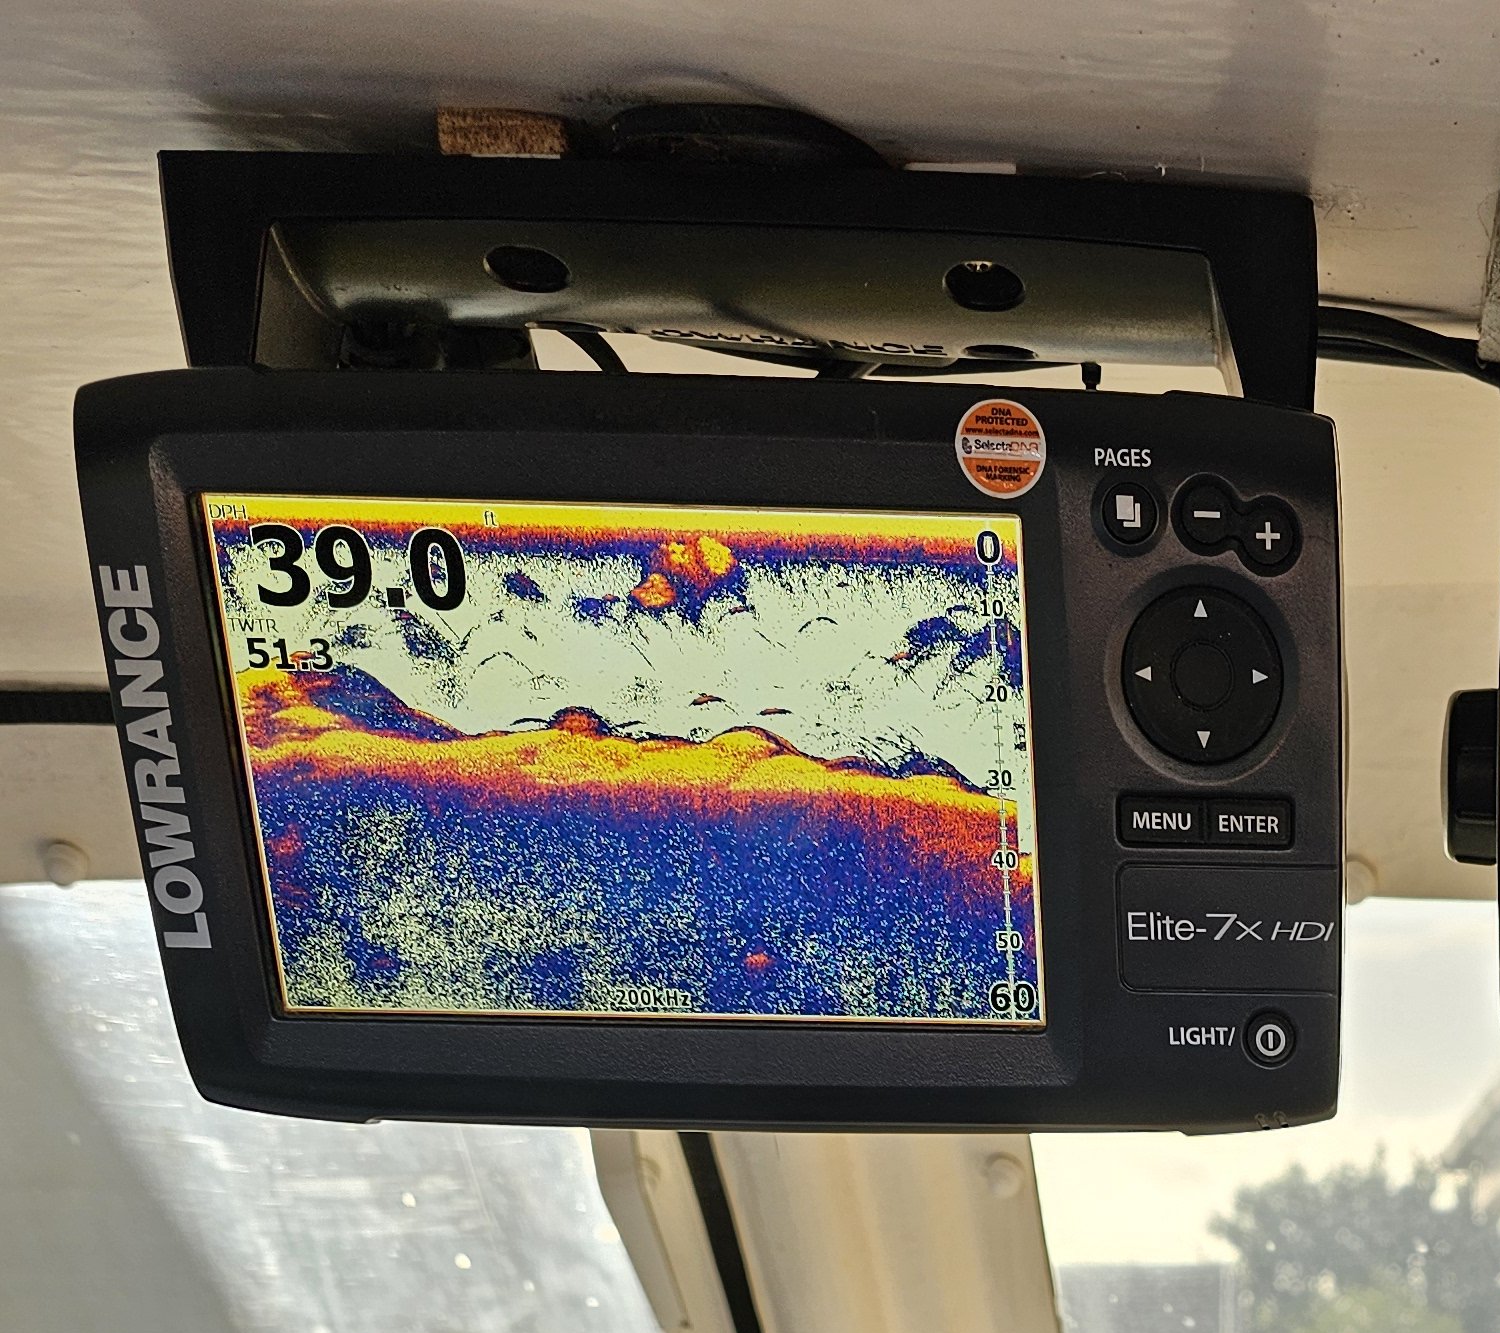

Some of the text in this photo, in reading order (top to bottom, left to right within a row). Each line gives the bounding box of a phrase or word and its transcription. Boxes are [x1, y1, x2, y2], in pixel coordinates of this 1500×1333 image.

[976, 416, 1028, 426] PROTECTED
[992, 408, 1011, 416] DNA
[1094, 448, 1152, 468] PAGES
[209, 504, 247, 520] DPH
[976, 531, 1002, 565] 0
[251, 524, 466, 611] 39.0
[980, 599, 1003, 618] 10
[229, 618, 277, 633] TWTR
[248, 638, 333, 671] 51.3
[985, 685, 1007, 704] 20
[100, 564, 211, 949] LOWRANCE
[988, 770, 1011, 789] 30
[1132, 810, 1191, 832] MENU
[1218, 815, 1278, 835] ENTER
[993, 851, 1016, 869] 40
[997, 932, 1021, 950] 50
[1270, 921, 1334, 942] HDI
[615, 988, 691, 1008] 200kHz
[989, 982, 1035, 1013] 60
